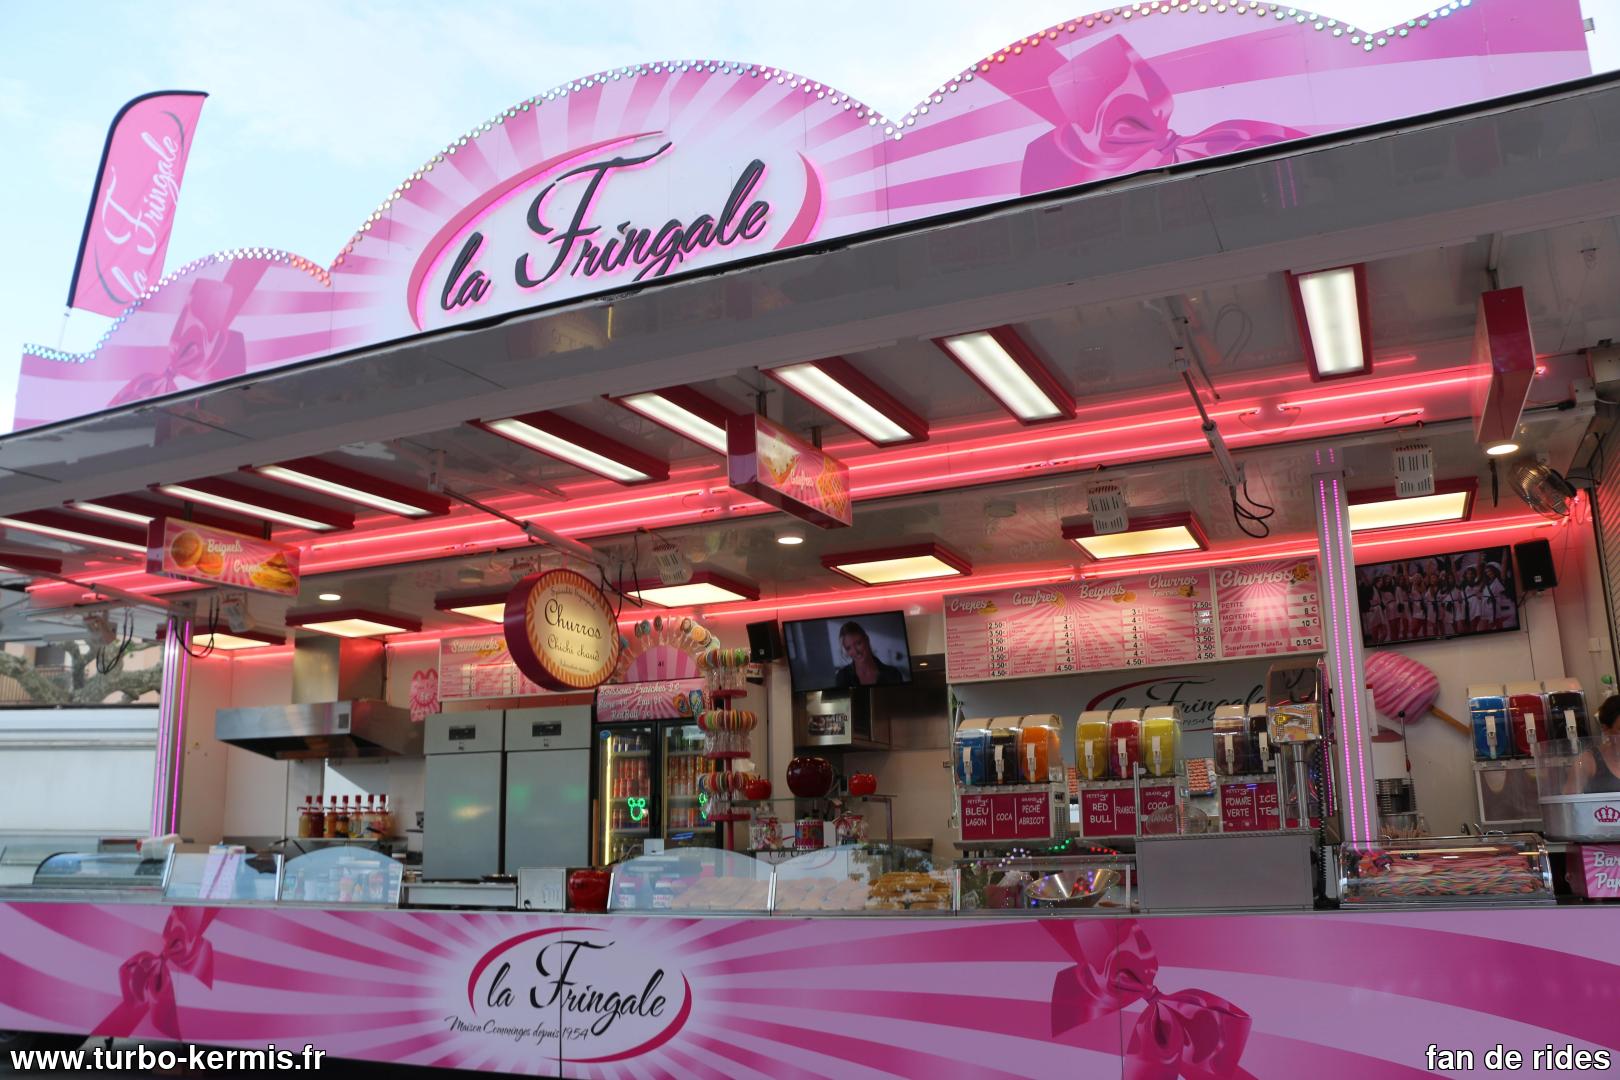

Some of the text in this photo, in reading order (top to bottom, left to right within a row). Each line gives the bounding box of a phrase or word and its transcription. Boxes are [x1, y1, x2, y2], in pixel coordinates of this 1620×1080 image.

[102, 131, 180, 255] Fringale
[440, 142, 770, 312] la Fringale
[1148, 575, 1199, 589] Churros
[1220, 569, 1295, 587] Churros
[1079, 584, 1126, 600] Beignets
[1012, 590, 1057, 607] Gaufres
[545, 599, 602, 640] Churros
[1222, 613, 1257, 621] MOYENNE
[1223, 625, 1253, 633] GRANDE
[547, 634, 600, 661] Chichi chaud
[1225, 796, 1252, 806] POMME
[1259, 794, 1277, 804] ICE
[1092, 803, 1108, 811] RED
[1147, 801, 1168, 810] COCO
[965, 806, 989, 816] BLEU
[1226, 807, 1250, 817] VERTE
[996, 813, 1012, 821] COCA
[1019, 817, 1045, 825] ABRICOT
[1090, 815, 1112, 823] BULL
[965, 818, 987, 827] LAGON
[487, 940, 666, 1036] la Fringale
[444, 1015, 482, 1034] Maison
[532, 1022, 559, 1046] depuis
[562, 1026, 589, 1041] 1954
